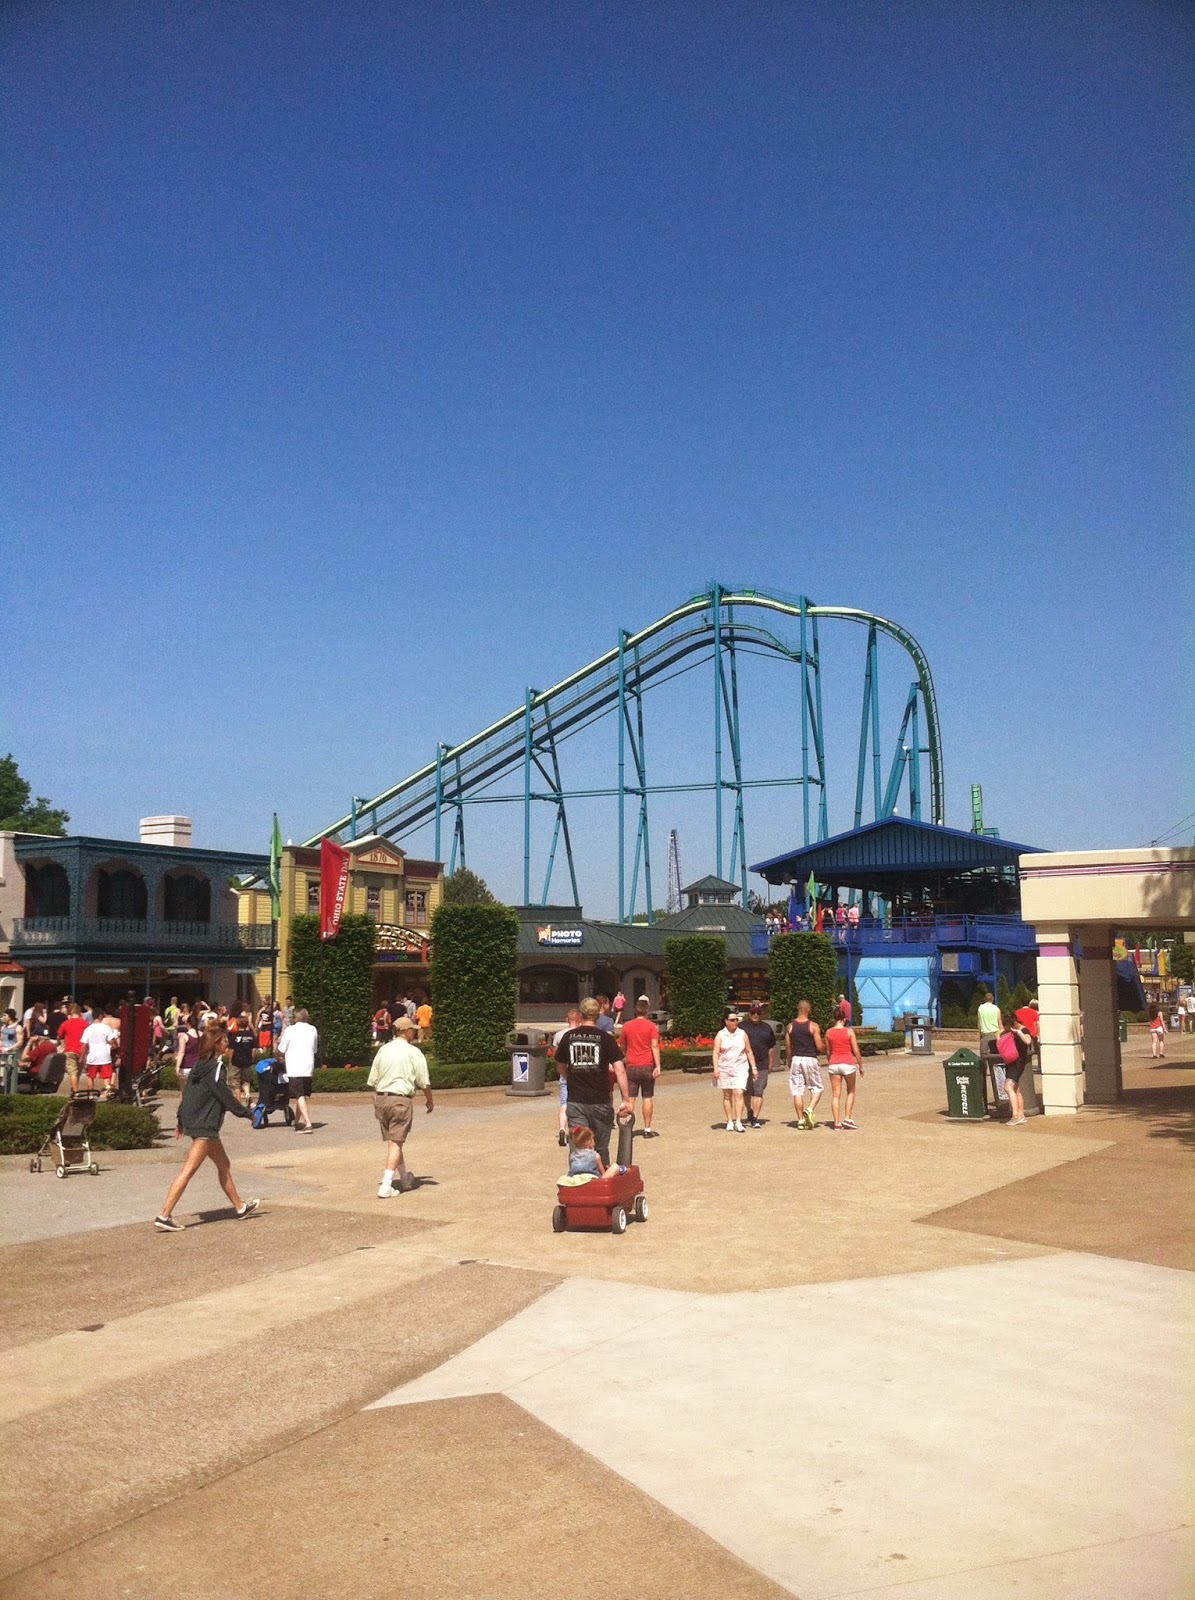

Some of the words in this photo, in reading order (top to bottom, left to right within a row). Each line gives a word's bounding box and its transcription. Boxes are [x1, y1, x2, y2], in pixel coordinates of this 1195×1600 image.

[336, 875, 347, 902] STATE
[332, 903, 342, 926] OHIO
[375, 924, 423, 947] LDRICH
[551, 930, 582, 938] PHOTO
[960, 1084, 968, 1116] RECYCLE
